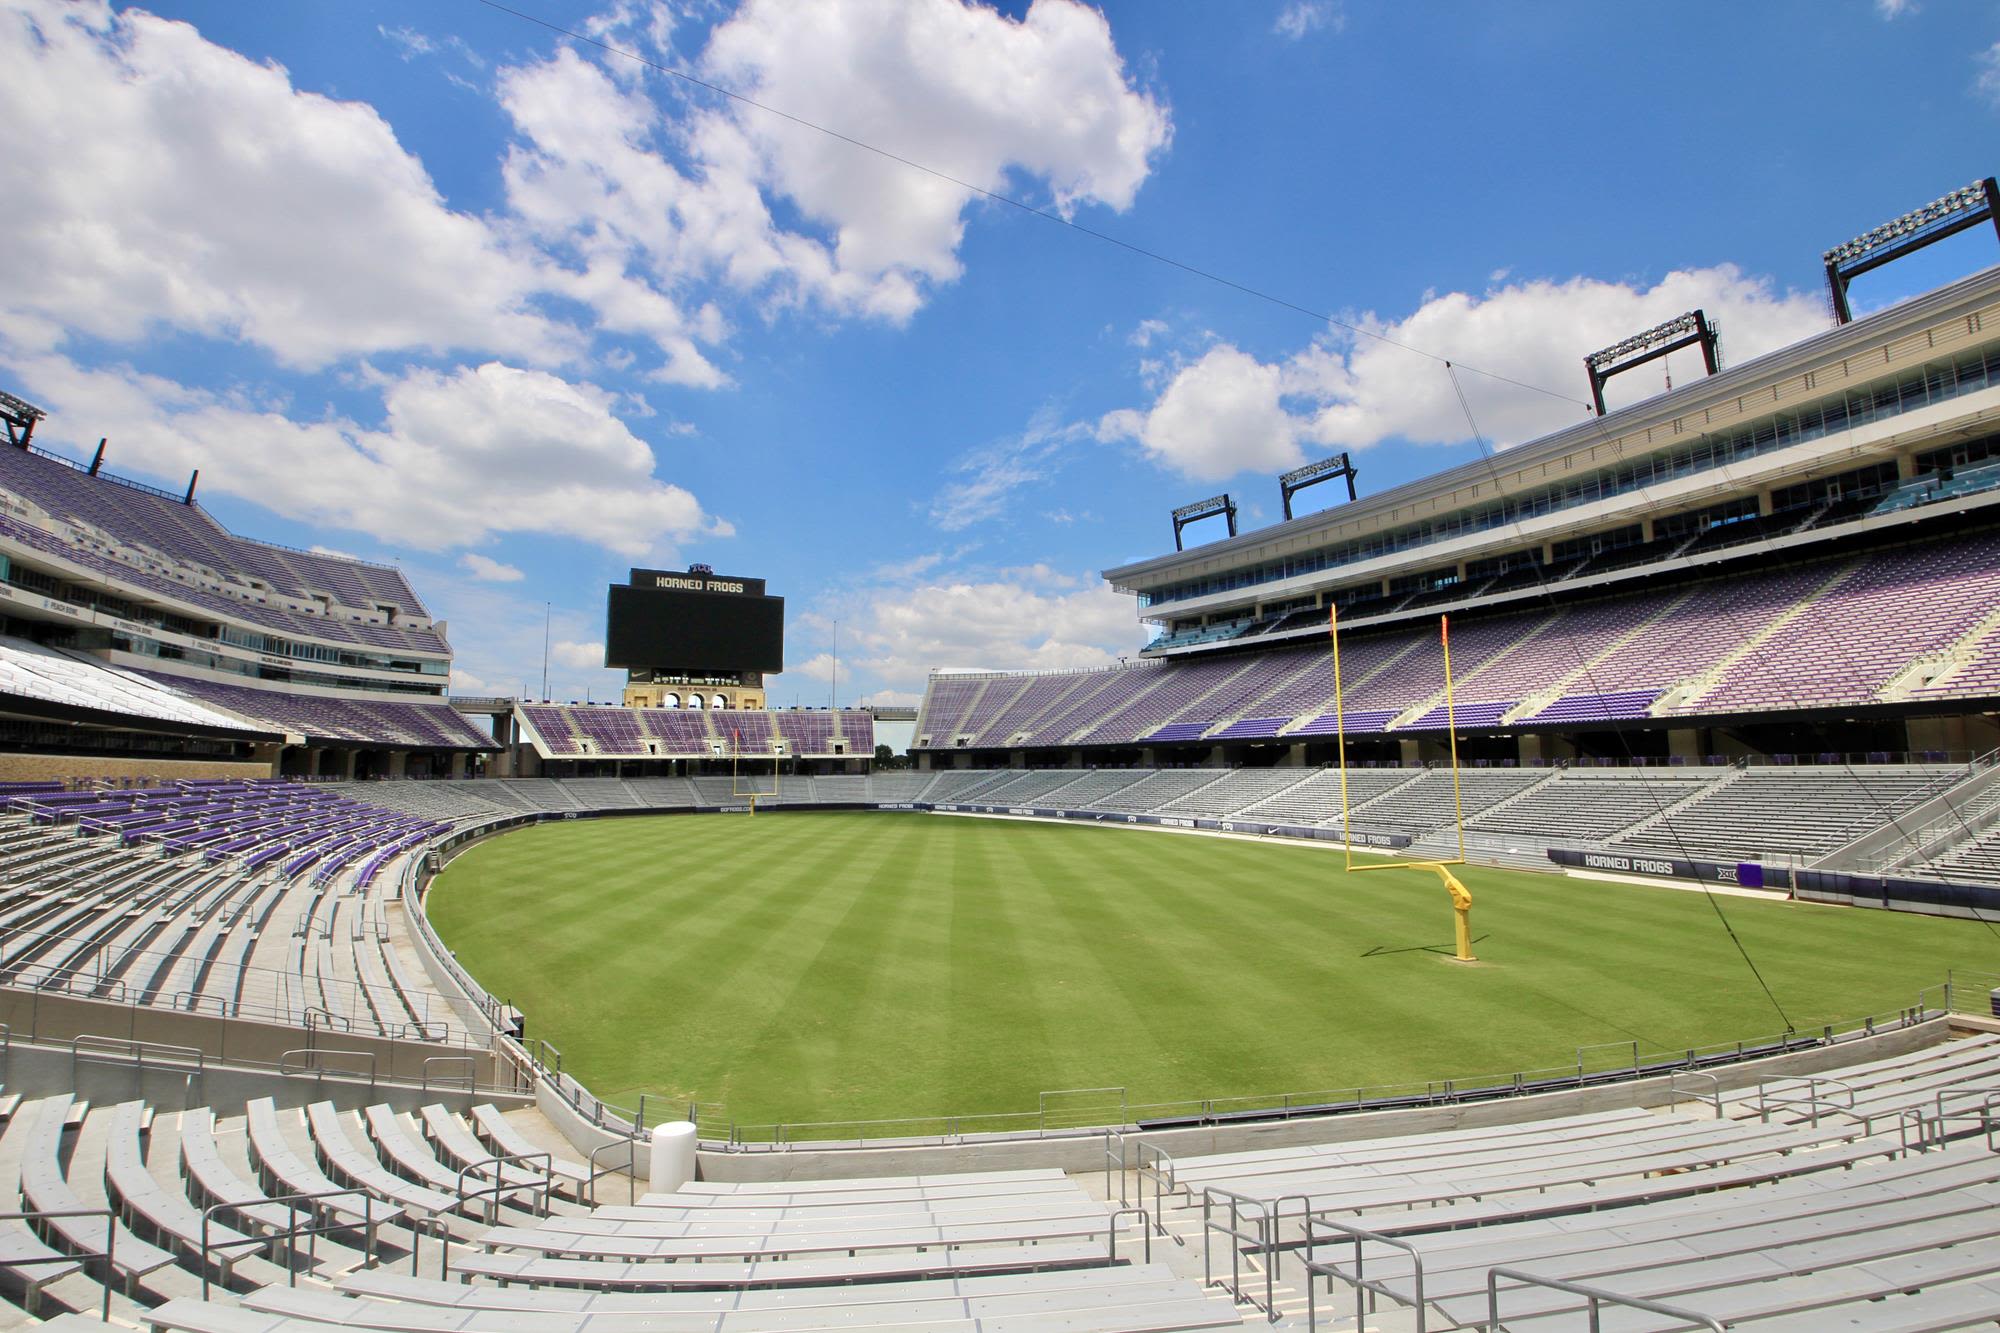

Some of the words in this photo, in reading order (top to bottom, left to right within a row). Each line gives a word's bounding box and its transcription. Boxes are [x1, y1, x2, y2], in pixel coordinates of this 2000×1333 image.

[656, 577, 703, 590] HORNED
[706, 581, 744, 593] FROGS
[1339, 832, 1366, 843] HRNED
[1367, 834, 1391, 846] FROGS
[1585, 854, 1630, 870] HORNED
[1633, 859, 1673, 874] FROGS
